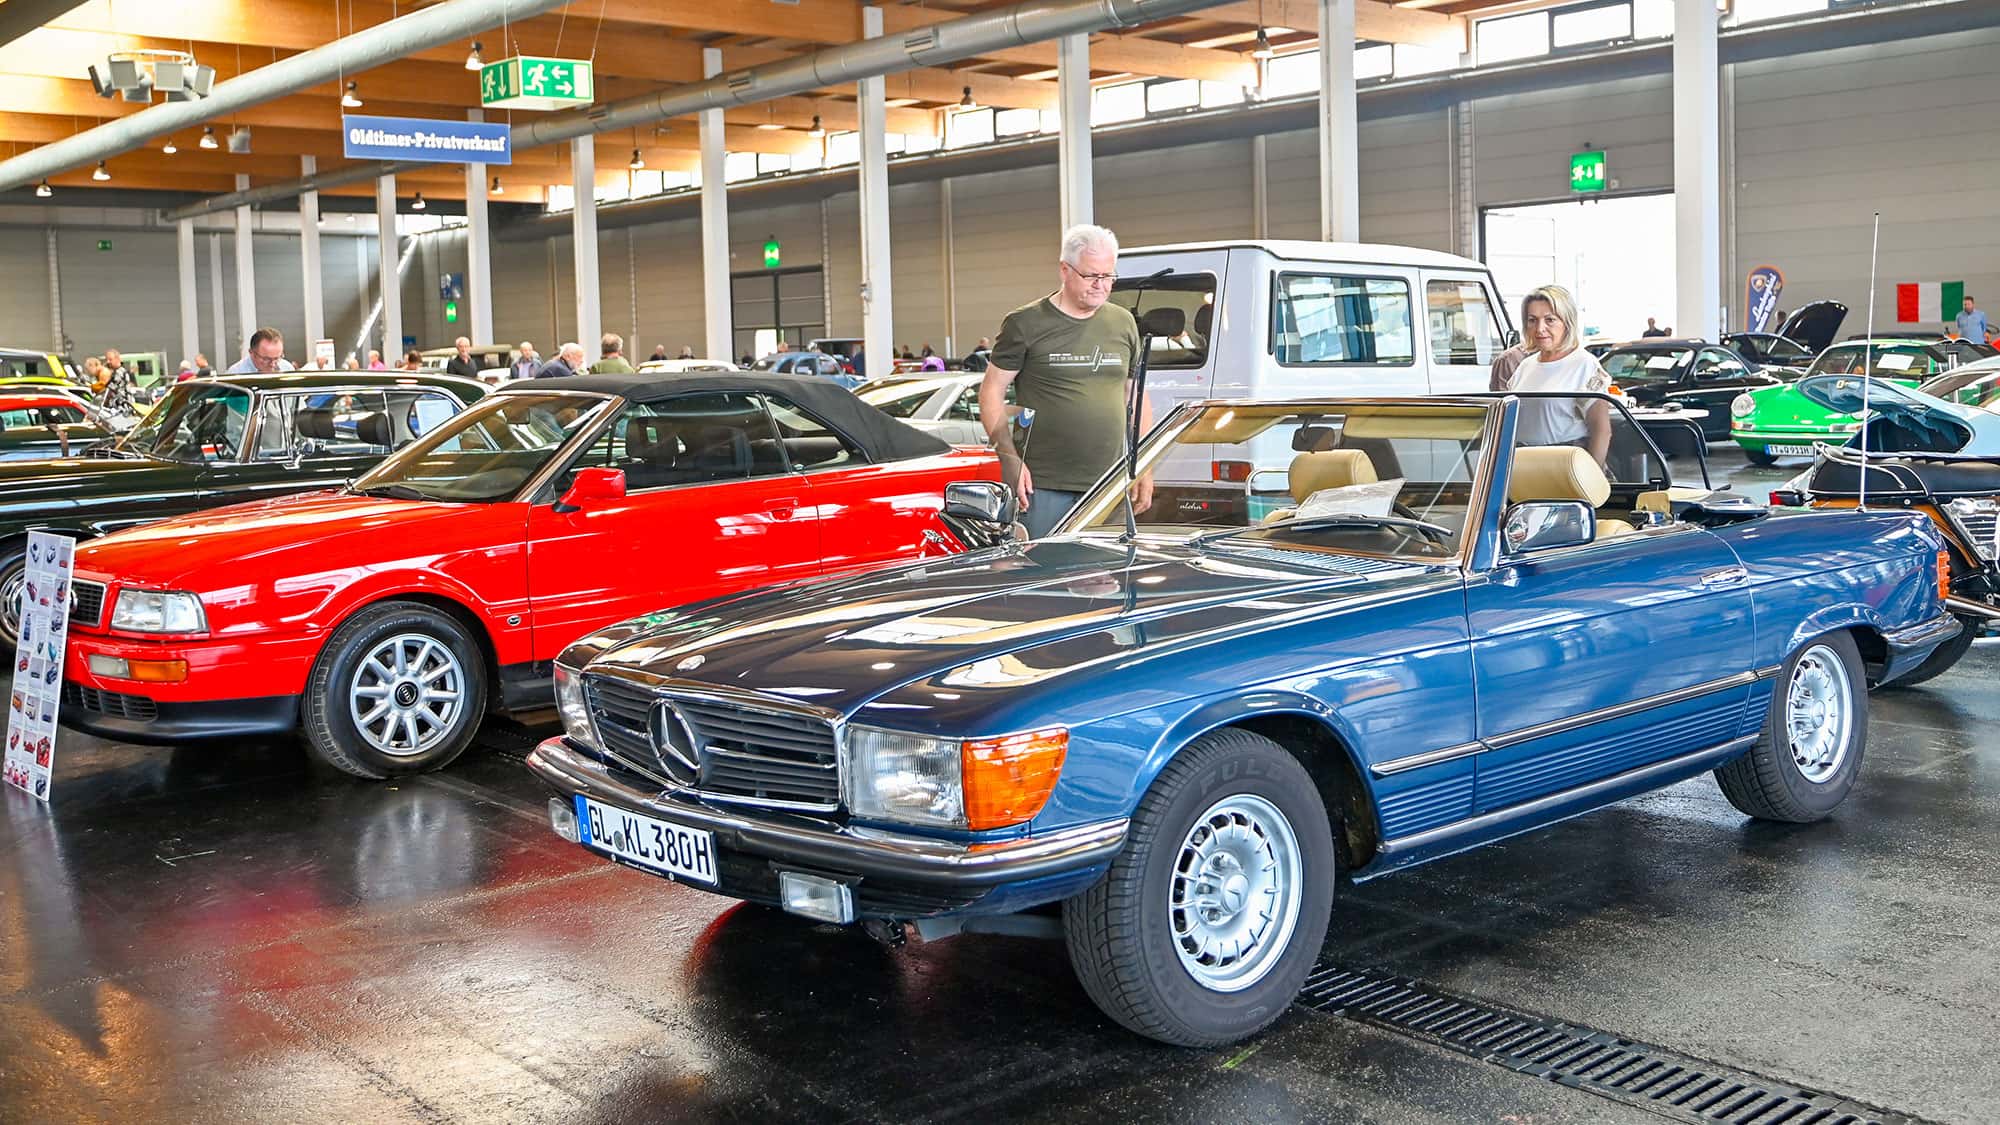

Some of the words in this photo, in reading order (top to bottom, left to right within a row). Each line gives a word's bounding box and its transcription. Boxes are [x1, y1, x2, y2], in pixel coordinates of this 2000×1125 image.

[350, 128, 506, 152] Oldtimer-Privatverkauf
[588, 805, 613, 846] GL
[622, 815, 650, 858] KL
[650, 824, 711, 876] 380H
